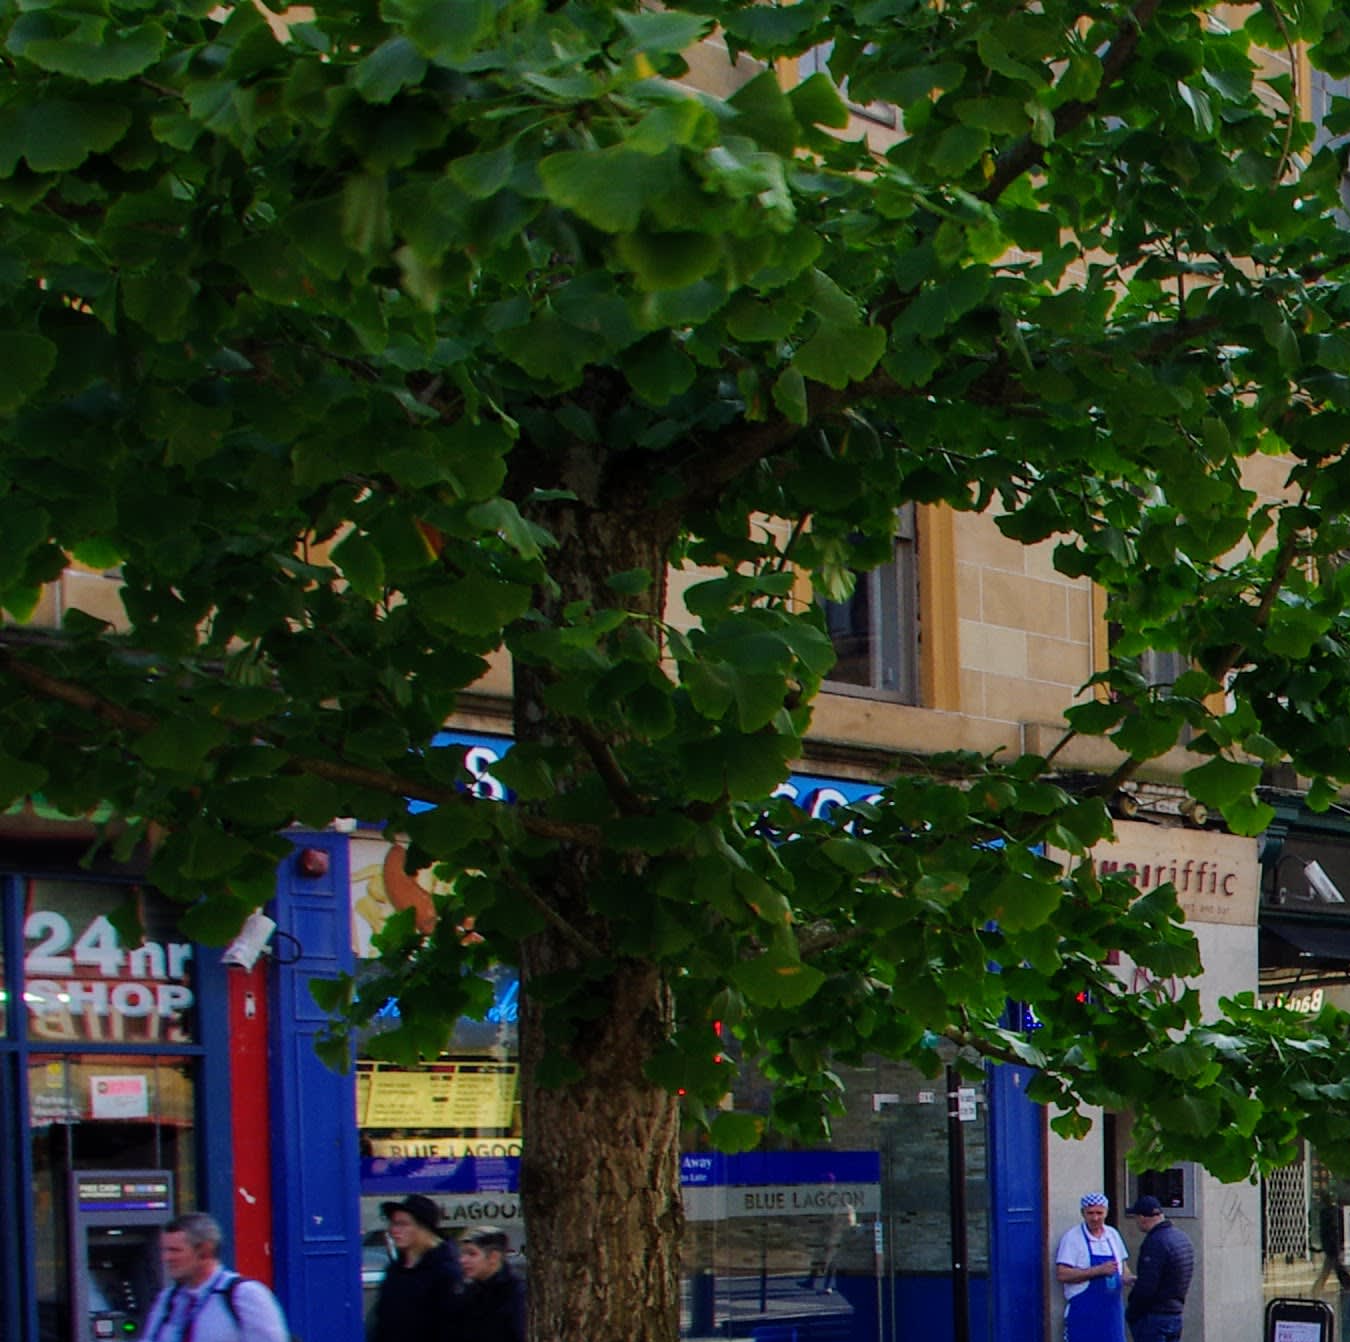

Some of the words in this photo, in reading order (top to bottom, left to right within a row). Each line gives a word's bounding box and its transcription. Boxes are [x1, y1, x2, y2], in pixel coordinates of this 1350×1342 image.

[24, 979, 195, 1018] SHOP
[743, 1192, 785, 1209] BLUE
[791, 1191, 866, 1209] LAGOON
